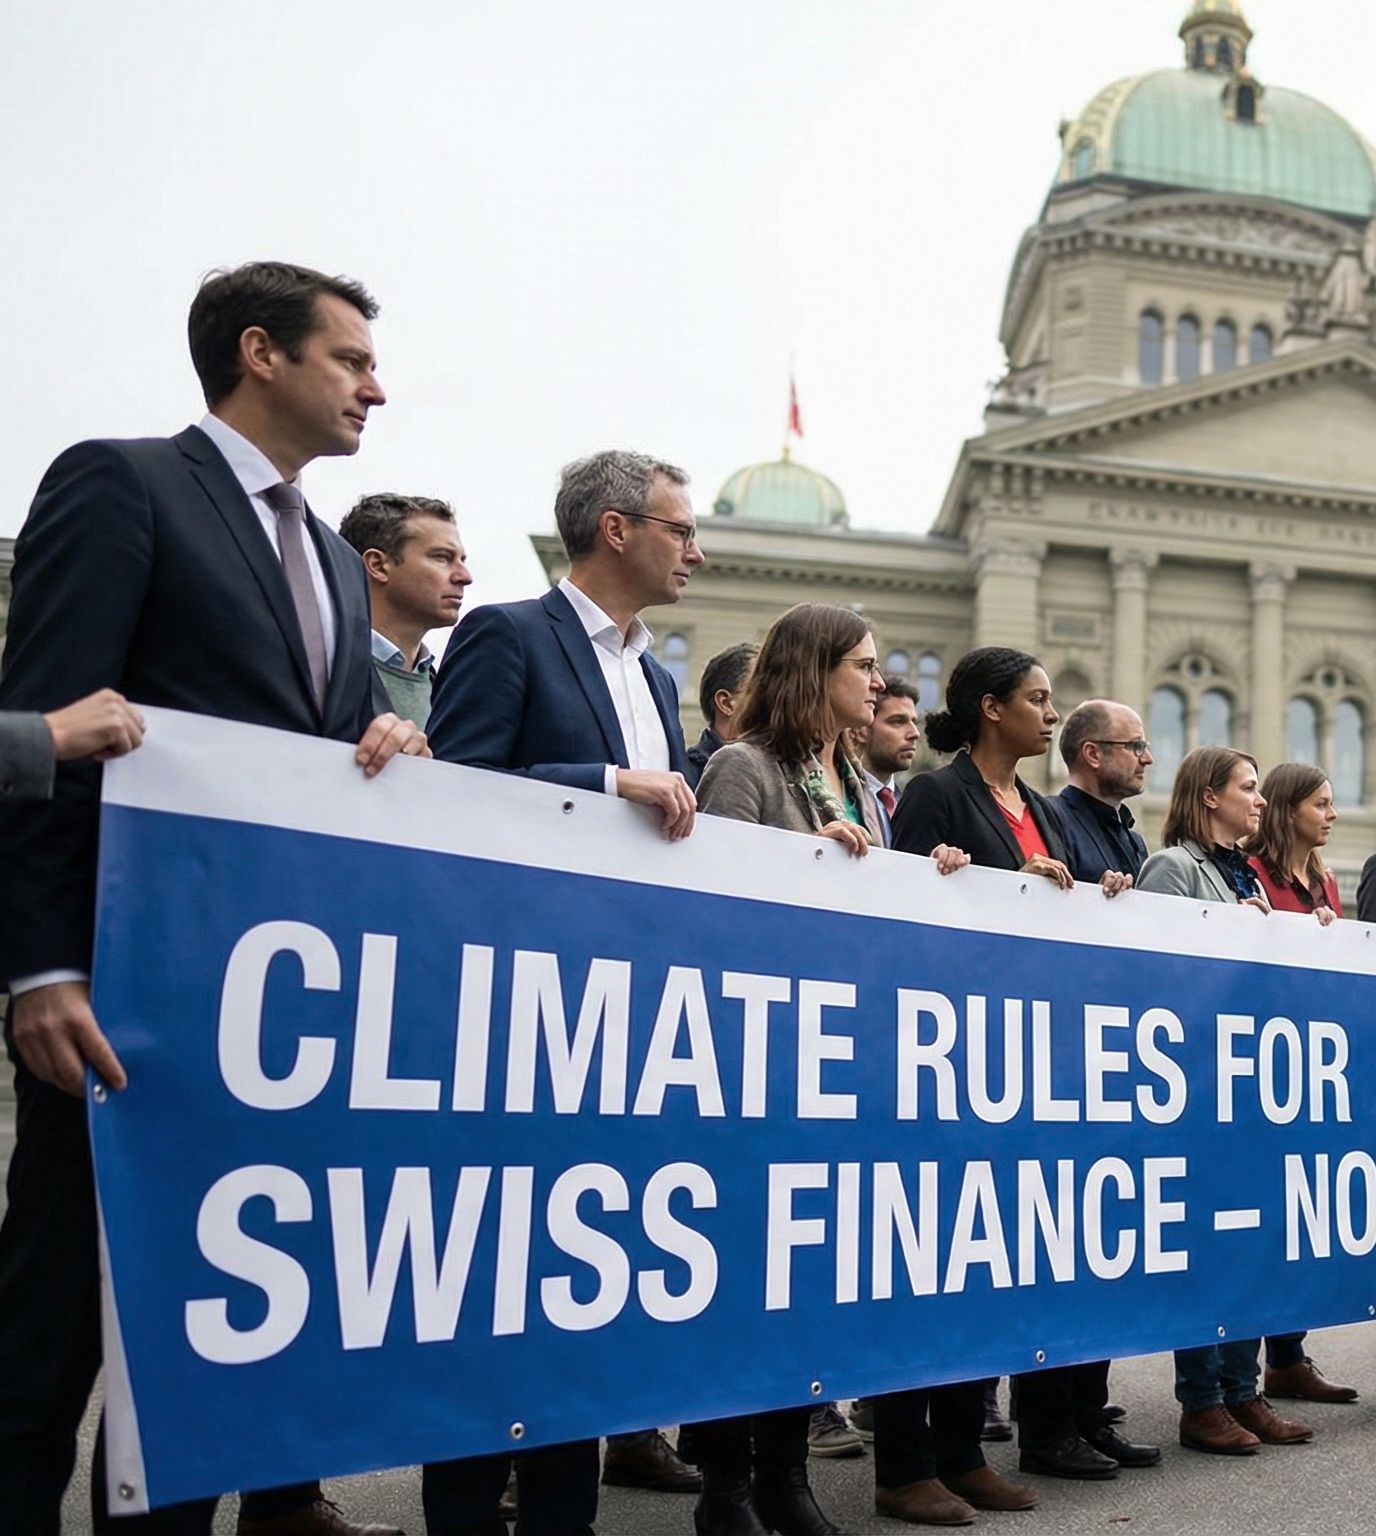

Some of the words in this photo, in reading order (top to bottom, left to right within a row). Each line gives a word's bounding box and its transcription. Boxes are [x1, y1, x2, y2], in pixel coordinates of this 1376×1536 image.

[218, 920, 857, 1119] CLIMATE
[897, 988, 1188, 1125] RULES
[1217, 1014, 1352, 1124] FOR
[185, 1162, 719, 1365] SWISS
[765, 1157, 1189, 1310] FINANCE
[1214, 1208, 1261, 1232] –
